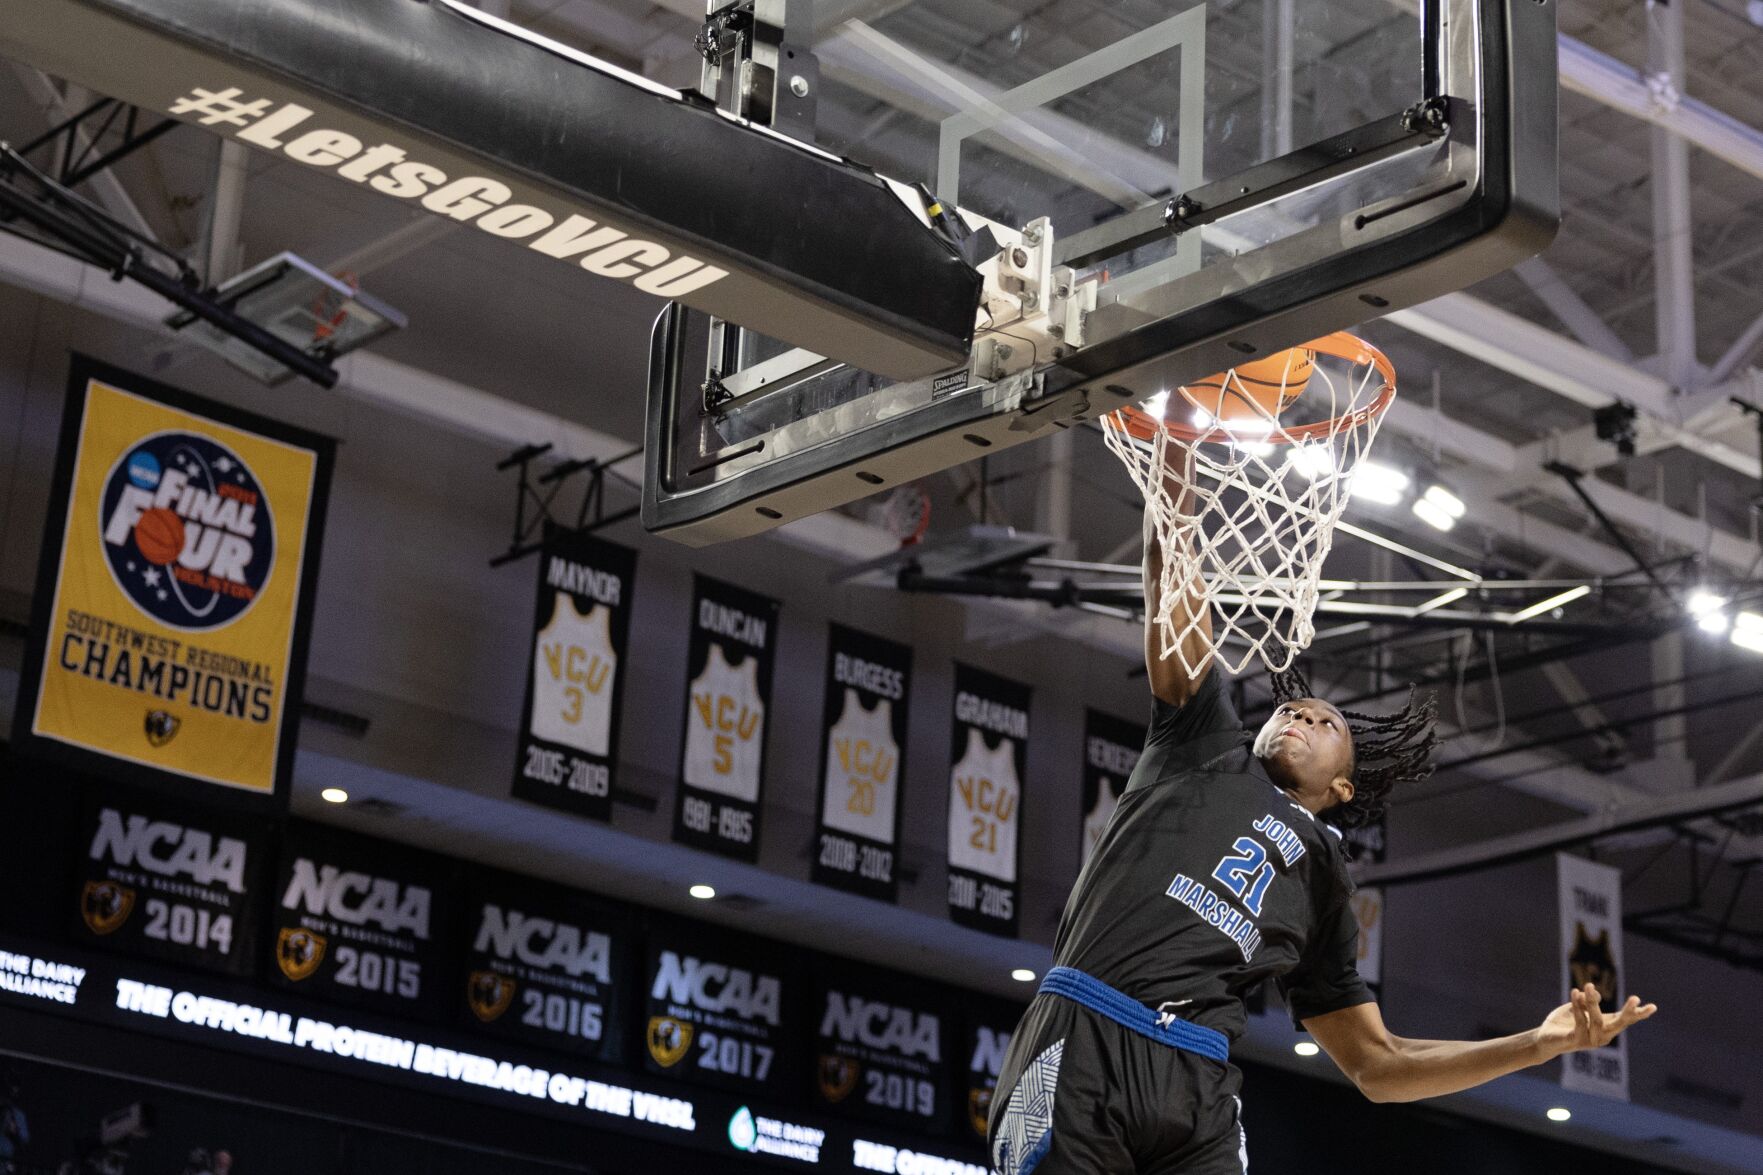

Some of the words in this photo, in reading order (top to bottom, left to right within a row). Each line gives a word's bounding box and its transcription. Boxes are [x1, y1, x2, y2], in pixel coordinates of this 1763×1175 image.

[168, 86, 729, 297] #LetsGoVCU
[934, 371, 967, 391] SPALDING
[155, 467, 257, 538] FINAL
[547, 556, 621, 606] MAYNOR
[66, 609, 181, 660] SOUTHWEST
[186, 646, 274, 686] REGIONAL
[700, 598, 766, 648] DUNCAN
[61, 634, 272, 724] CHAMPIONS
[544, 643, 609, 695] VCU
[835, 652, 903, 700] BURGESS
[562, 686, 583, 725] 3
[695, 692, 758, 741] VCU
[956, 691, 1028, 739] GRAHAM
[713, 735, 733, 775] 5
[835, 738, 893, 784] VCU
[848, 778, 874, 817] 20
[958, 775, 1014, 822] VCU
[89, 808, 247, 894] NCAA
[969, 817, 997, 854] 21
[1253, 814, 1306, 867] JOHN
[281, 858, 431, 940] NCAA
[1211, 837, 1276, 918] 21
[144, 899, 233, 954] 2014
[474, 904, 611, 984] NCAA
[1165, 873, 1261, 963] MARSHALL
[31, 959, 86, 987] DAIRY
[334, 946, 421, 999] 2015
[652, 951, 780, 1026] NCAA
[522, 988, 602, 1041] 2016
[819, 990, 941, 1063] NCAA
[116, 978, 173, 1018] THE
[171, 991, 294, 1044] OFFICIAL
[294, 1017, 415, 1070] PROTEIN
[413, 1043, 549, 1098] BEVERAGE
[548, 1072, 587, 1106] OF
[585, 1080, 632, 1117] THE
[698, 1033, 775, 1081] 2017
[865, 1069, 936, 1116] 2019
[853, 1139, 897, 1174] THE
